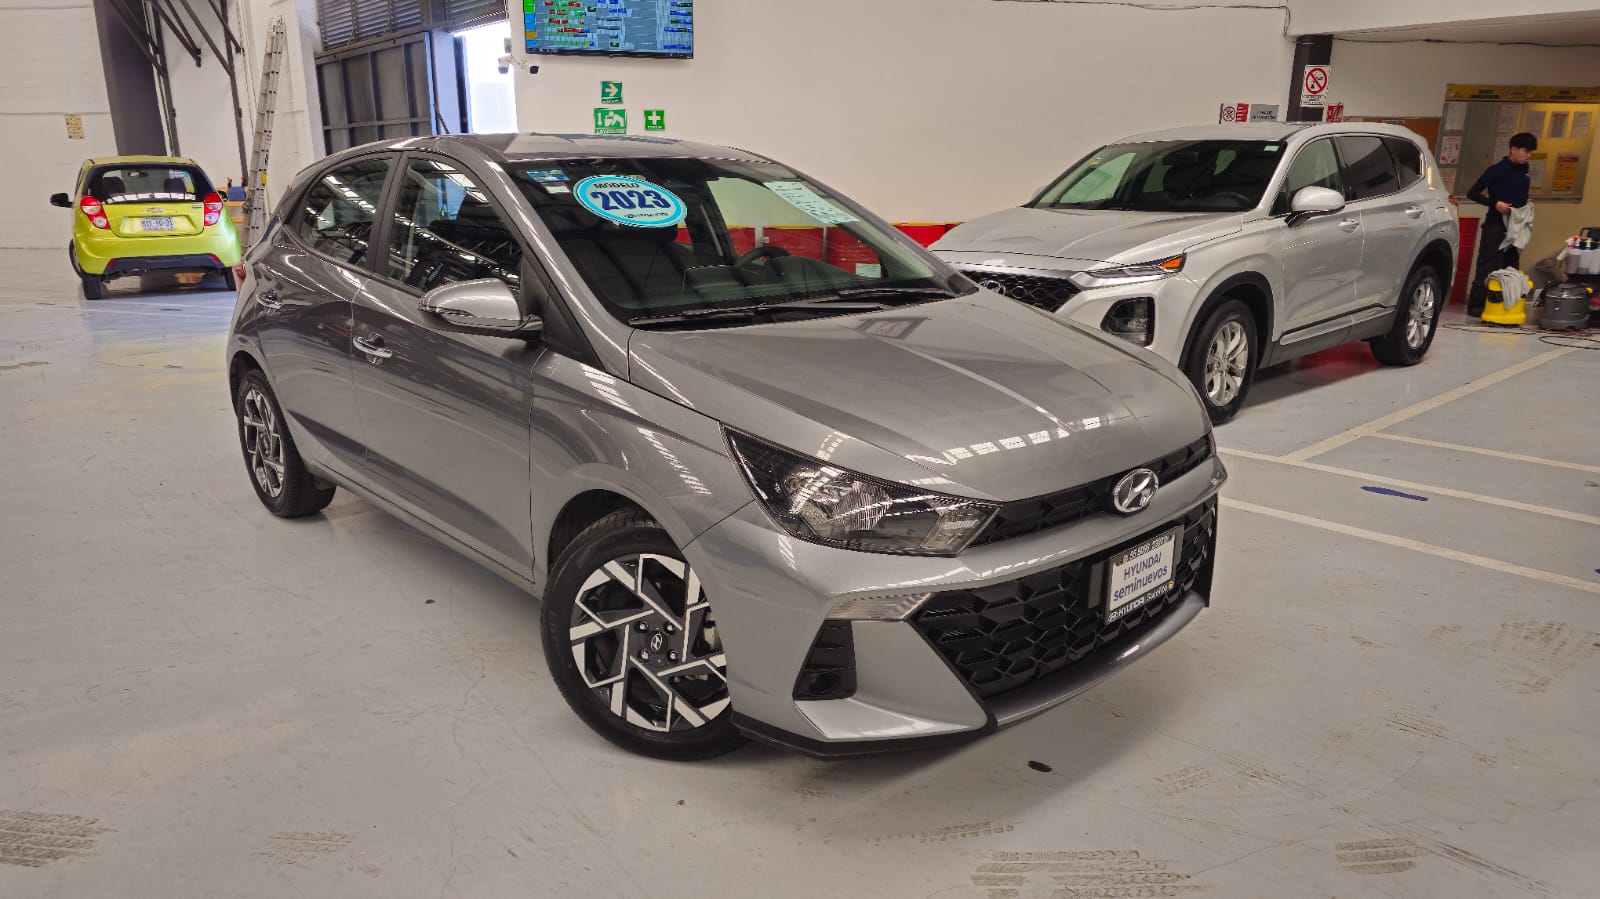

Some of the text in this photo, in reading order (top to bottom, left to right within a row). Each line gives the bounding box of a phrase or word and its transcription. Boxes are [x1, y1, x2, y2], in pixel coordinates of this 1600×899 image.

[591, 190, 671, 210] 2023
[1123, 552, 1162, 580] HYUNDAI
[1113, 565, 1168, 602] seminuevos
